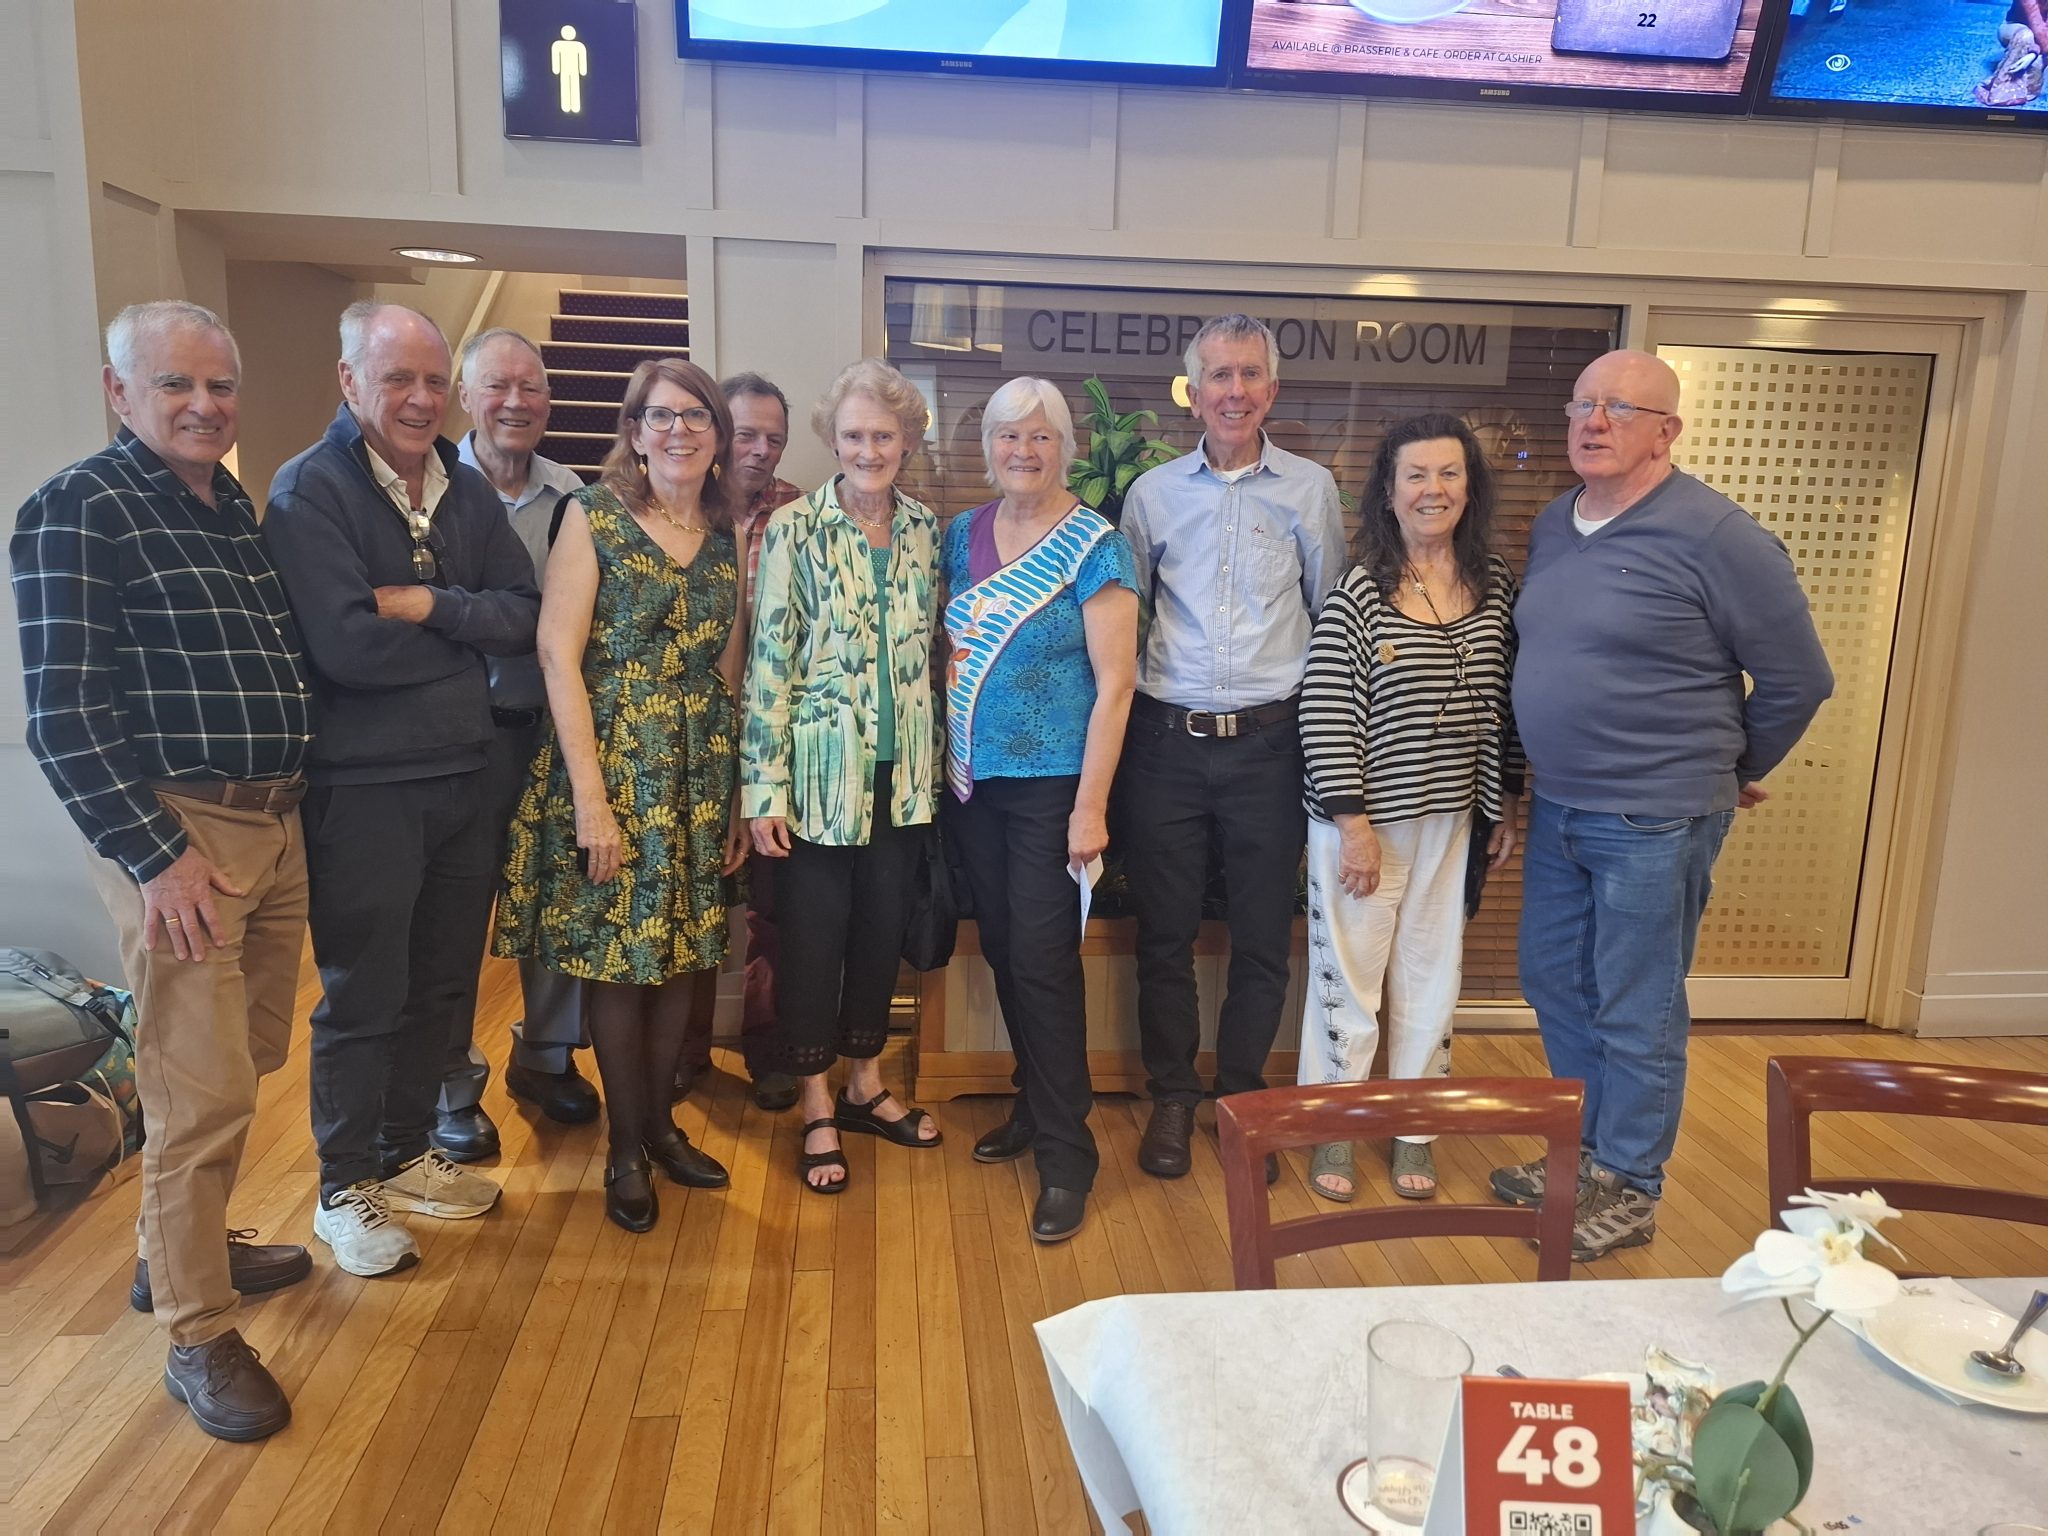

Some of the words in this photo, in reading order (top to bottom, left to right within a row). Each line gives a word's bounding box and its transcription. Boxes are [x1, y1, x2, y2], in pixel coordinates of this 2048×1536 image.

[1637, 12, 1657, 28] 22
[1272, 40, 1329, 53] AVAILABLE
[1331, 43, 1342, 55] @
[1344, 44, 1401, 57] BRASSERIE
[1403, 47, 1410, 57] &
[1443, 49, 1482, 61] ORDER
[1483, 52, 1496, 61] AT
[1498, 52, 1543, 64] CASHIER
[1480, 88, 1510, 96] SAMSUNG
[1027, 309, 1336, 361] CELEBRON
[1353, 320, 1488, 366] ROOM
[1510, 1401, 1574, 1420] TABLE
[1497, 1424, 1601, 1488] 48
